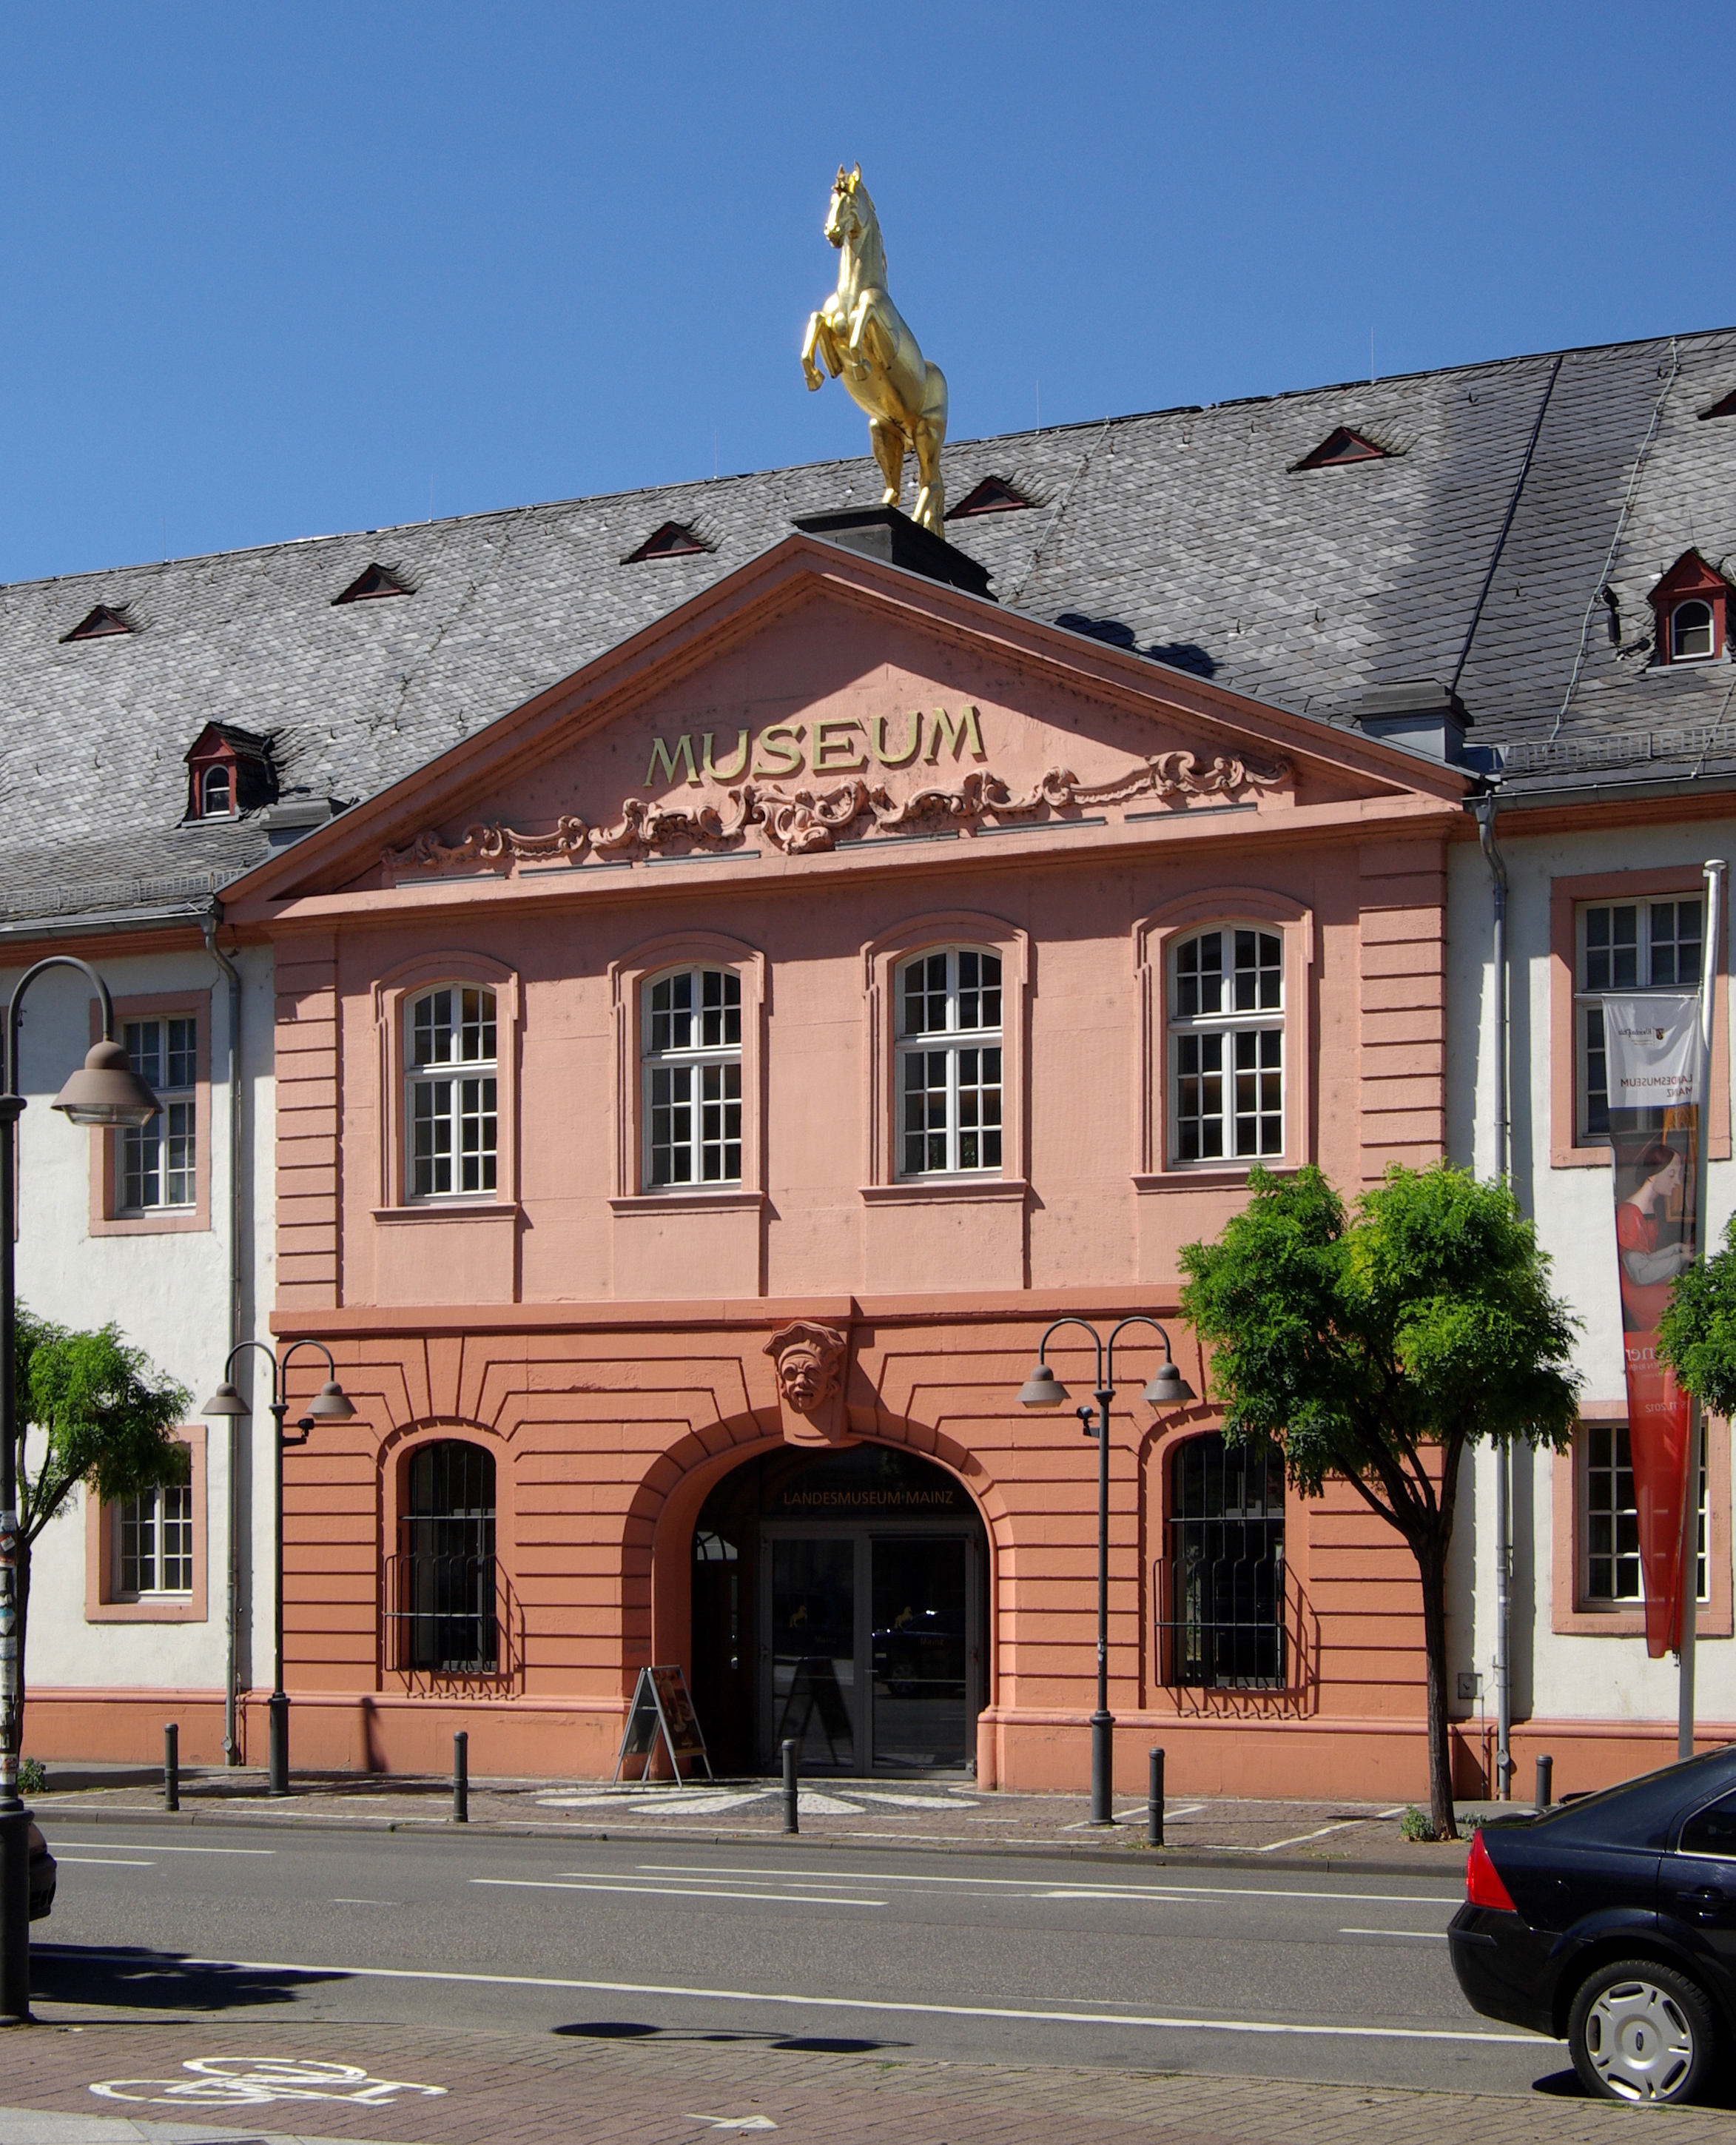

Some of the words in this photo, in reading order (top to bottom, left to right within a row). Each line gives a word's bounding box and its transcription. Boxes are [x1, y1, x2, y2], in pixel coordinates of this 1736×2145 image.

[643, 704, 983, 788] MUSEUM
[784, 1491, 901, 1505] LANDESMUSEUM
[906, 1490, 954, 1505] MAINZ
